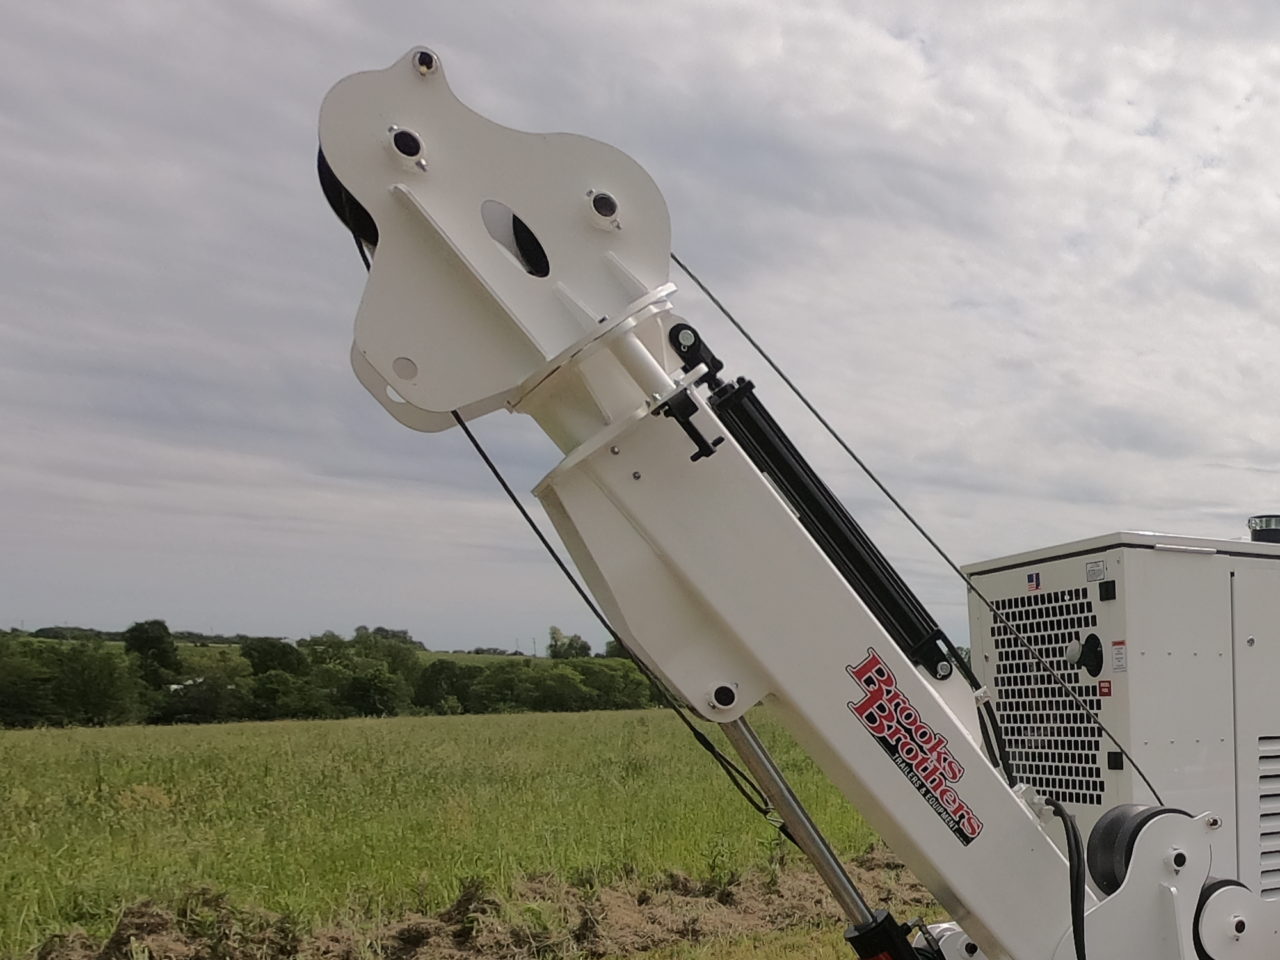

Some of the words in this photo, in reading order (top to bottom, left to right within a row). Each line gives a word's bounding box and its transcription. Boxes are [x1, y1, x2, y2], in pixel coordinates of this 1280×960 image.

[847, 648, 963, 782] Brooks
[848, 694, 982, 837] Brothers
[892, 752, 921, 788] TRAILERS
[919, 786, 927, 795] &
[925, 793, 958, 831] EQUIPMENT
